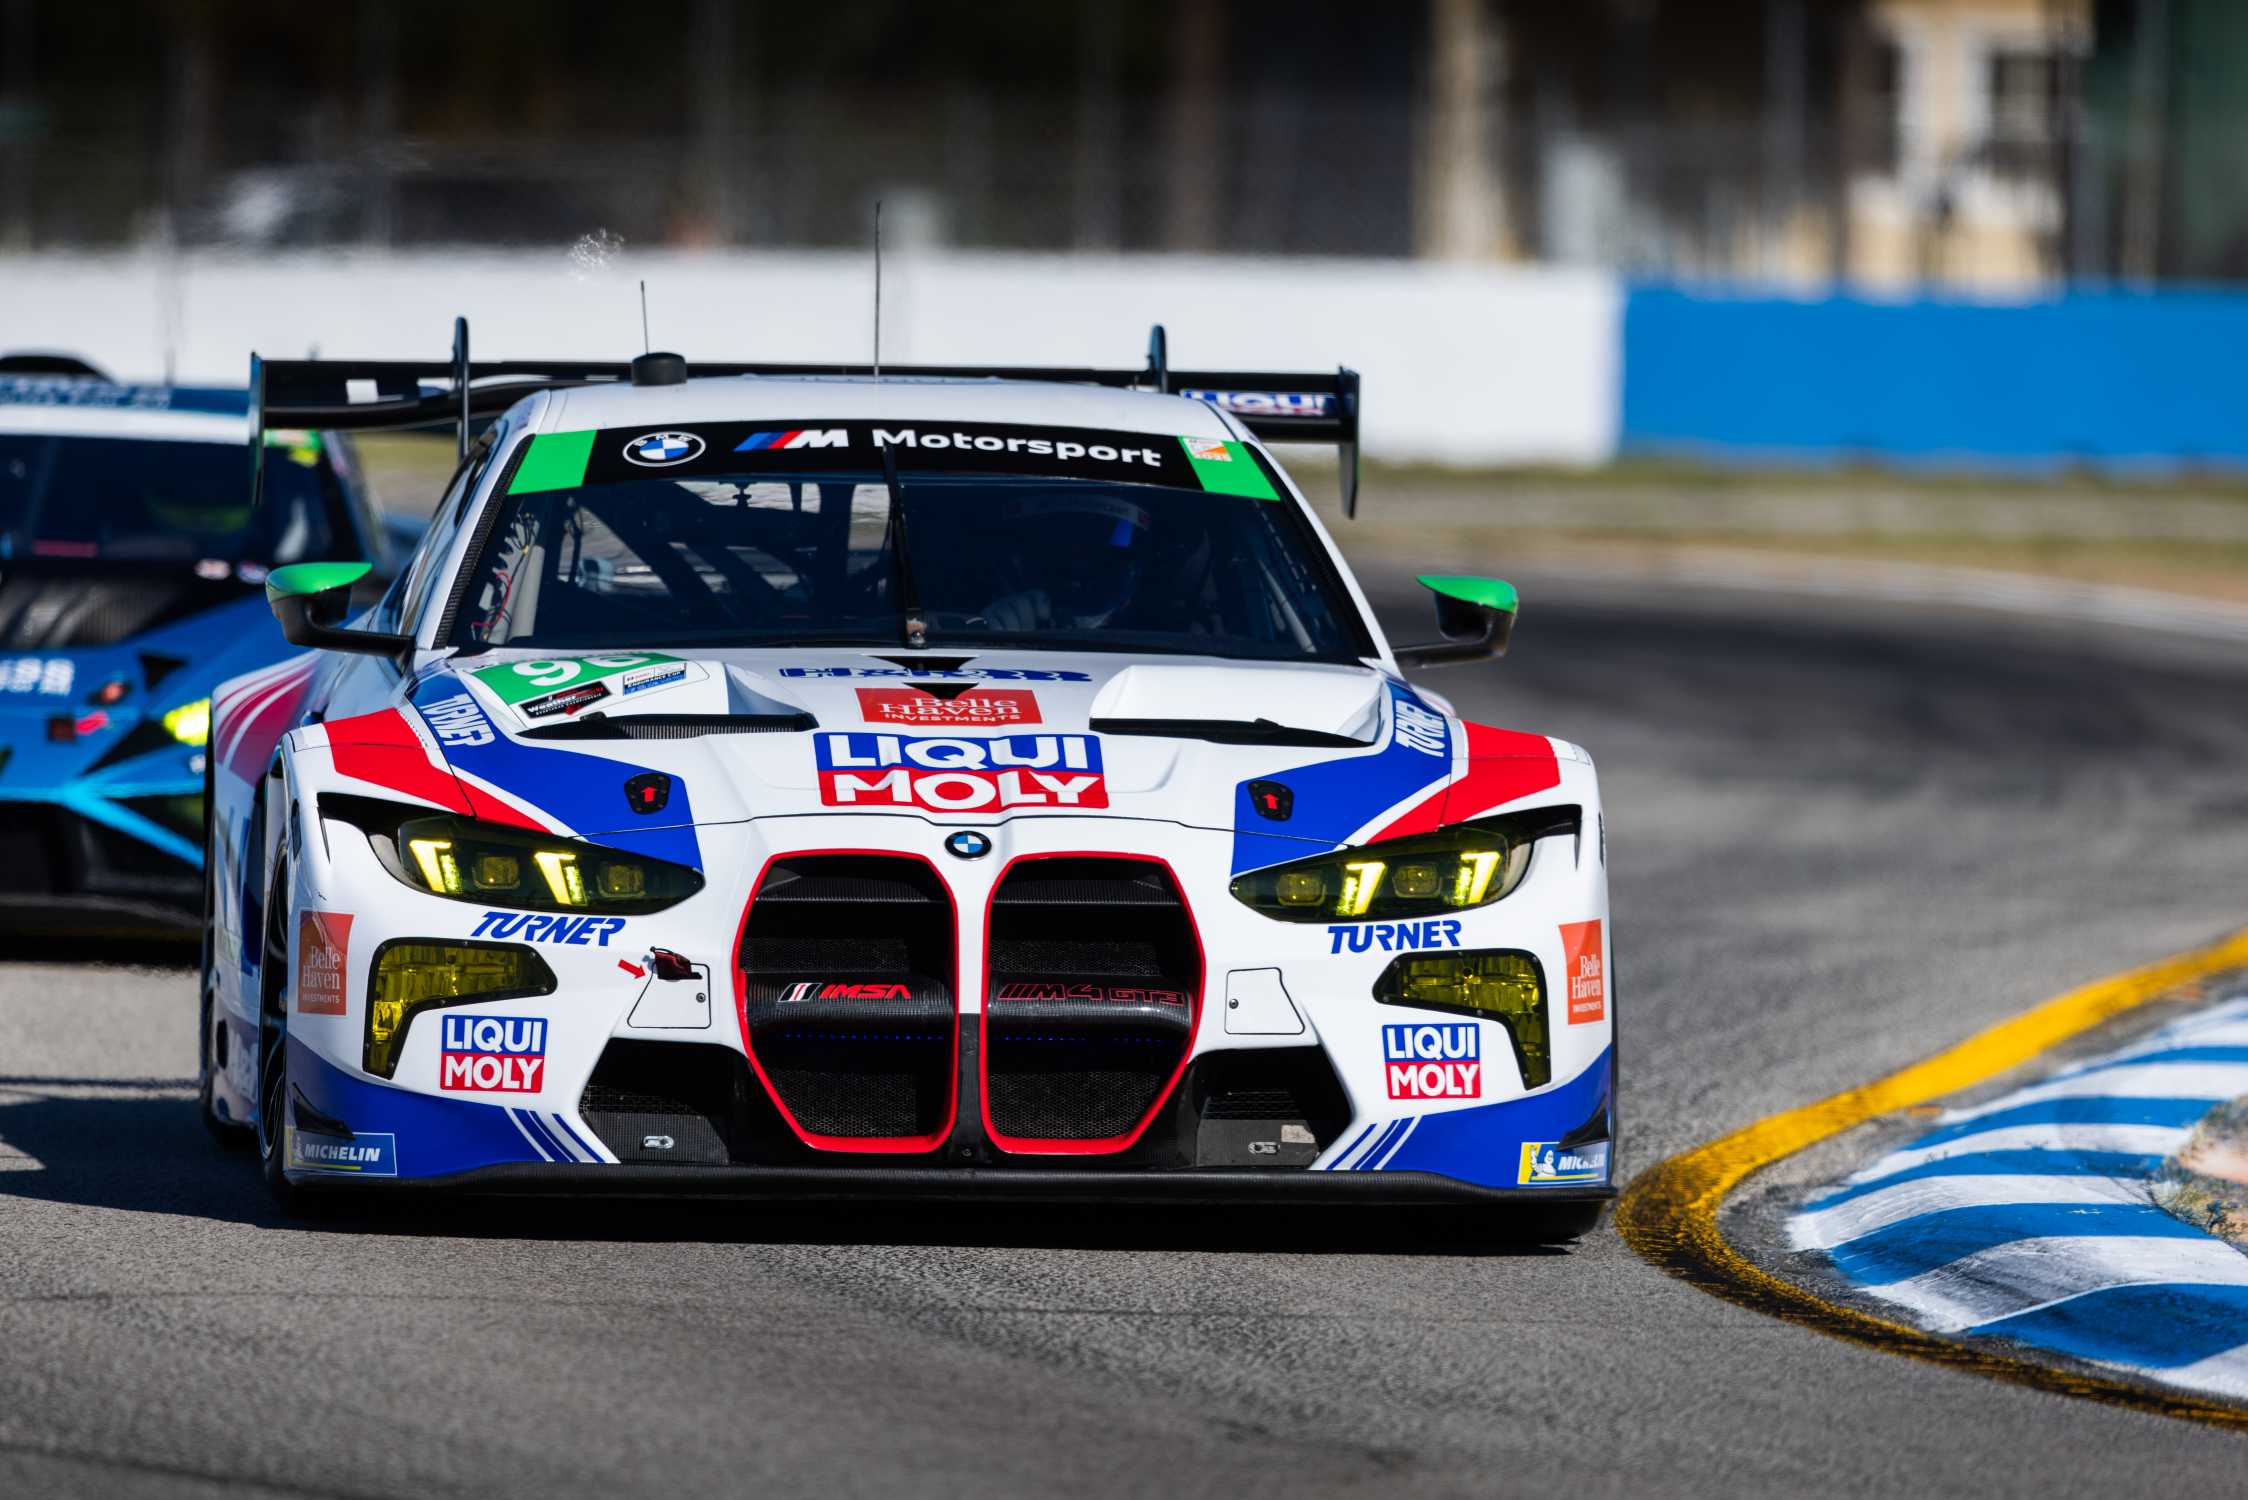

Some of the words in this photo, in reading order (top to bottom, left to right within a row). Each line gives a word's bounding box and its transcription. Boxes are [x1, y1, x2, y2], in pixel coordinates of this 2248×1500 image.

[871, 429, 1162, 467] Motorsport
[880, 703, 1022, 716] Haven
[884, 713, 1020, 722] INVESTMENTS
[914, 697, 1018, 708] Belle
[828, 734, 1089, 770] LIQUI
[833, 769, 1100, 810] MOLY
[471, 911, 626, 947] TURNER
[1328, 919, 1462, 954] TURNER
[311, 944, 341, 969] Belle
[303, 964, 340, 990] Haven
[819, 983, 912, 999] IMSA
[447, 1018, 543, 1053] LIQUI
[1387, 1026, 1476, 1060] LIQUI
[445, 1056, 544, 1089] MOLY
[1390, 1063, 1480, 1097] MOLY
[304, 1143, 380, 1162] MICHELIN
